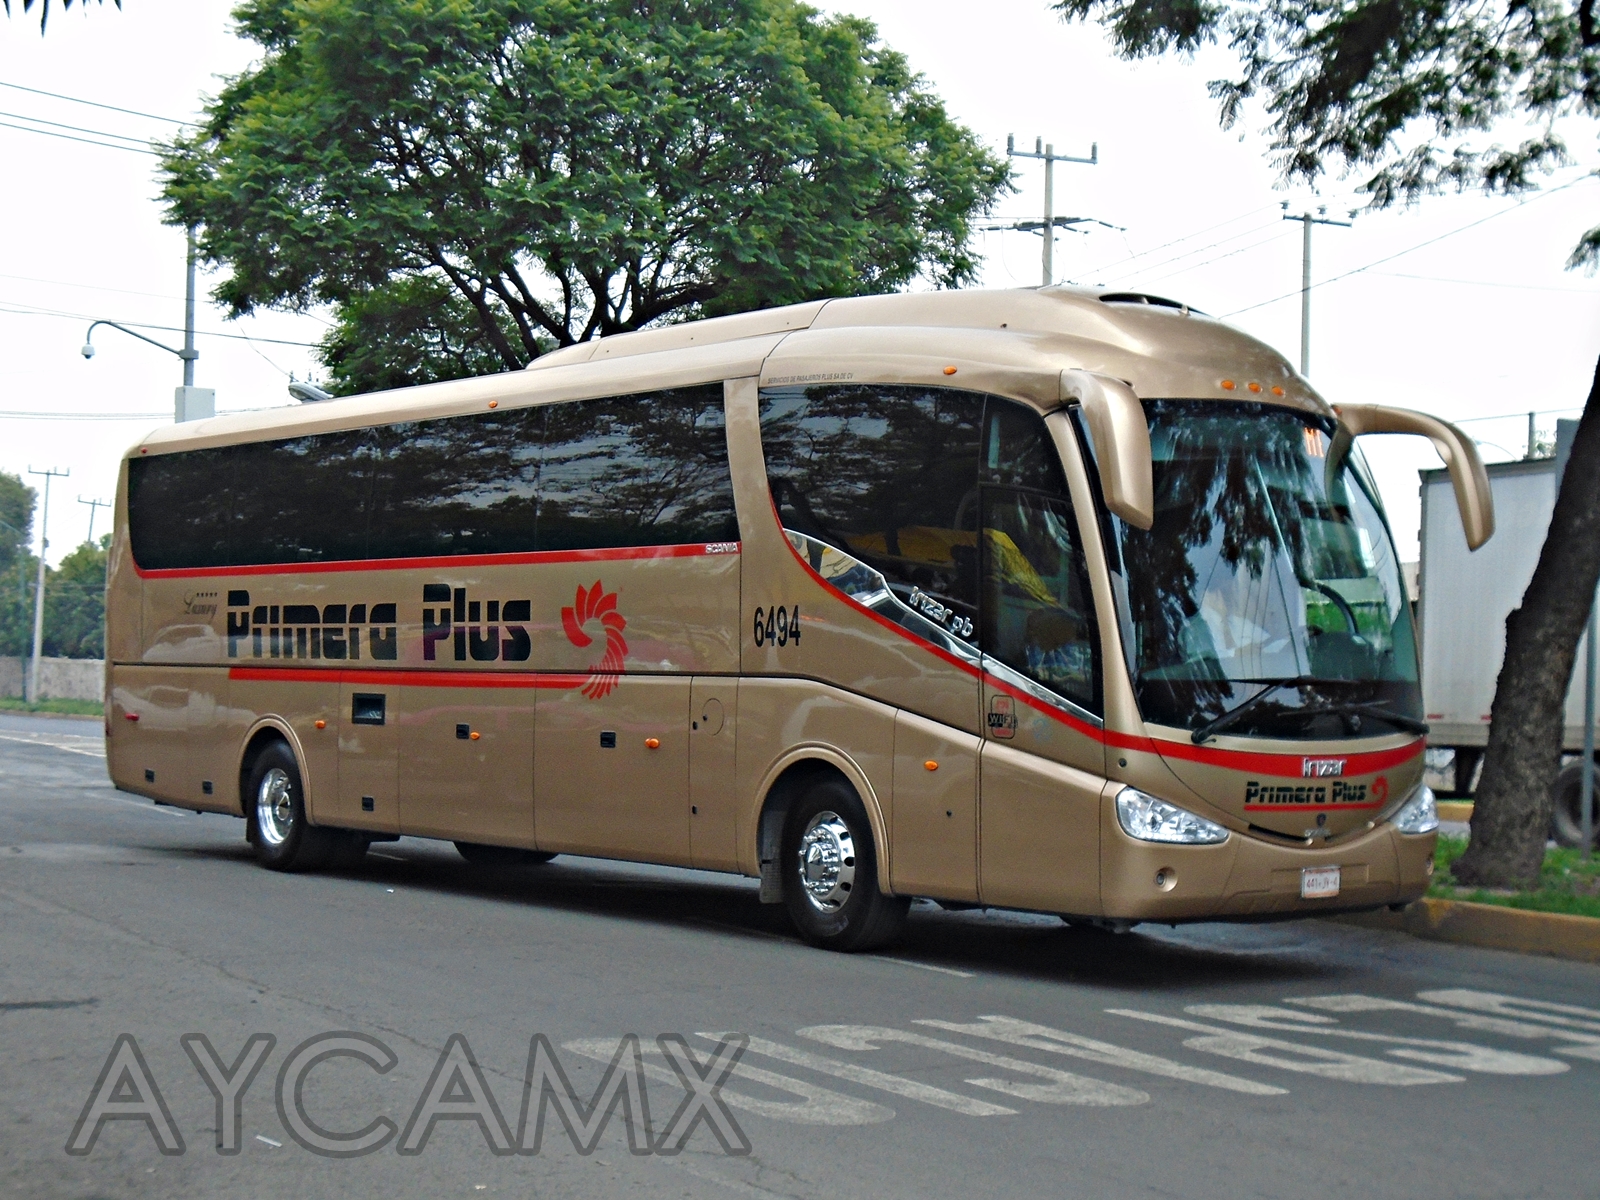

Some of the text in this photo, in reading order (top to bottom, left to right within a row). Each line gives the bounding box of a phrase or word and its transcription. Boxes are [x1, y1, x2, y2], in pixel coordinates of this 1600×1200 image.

[705, 542, 739, 554] SCANIA
[227, 583, 531, 661] Primera Plus
[753, 604, 801, 648] 6494
[1245, 781, 1367, 803] Primera Plus
